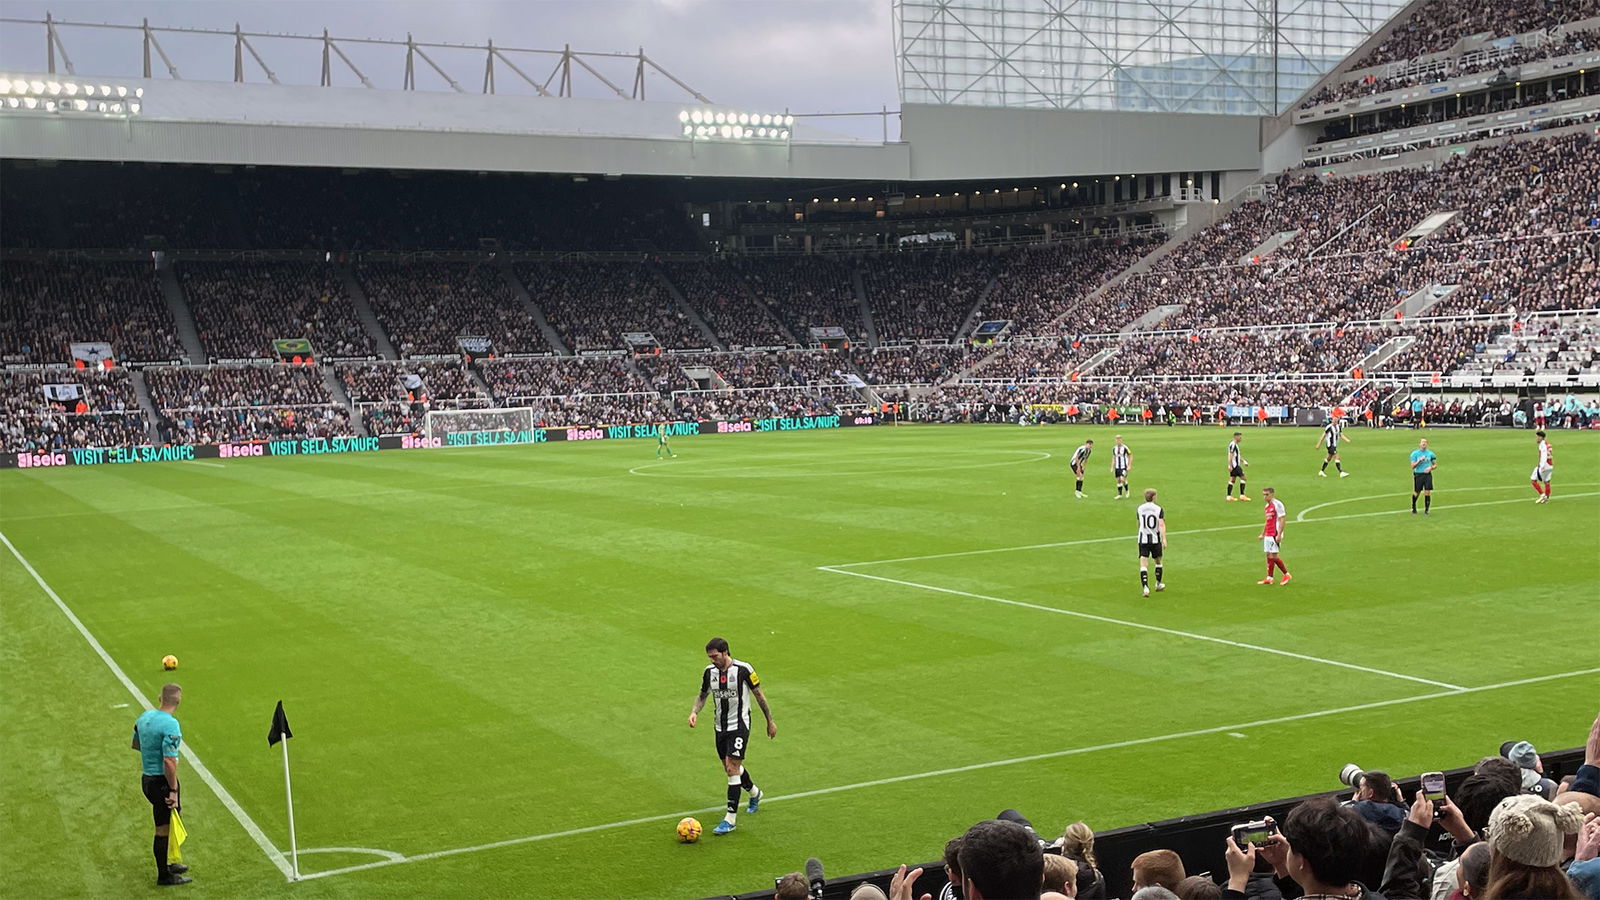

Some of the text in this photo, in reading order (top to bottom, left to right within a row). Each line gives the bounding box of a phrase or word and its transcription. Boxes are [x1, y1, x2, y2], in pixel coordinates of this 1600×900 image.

[578, 422, 700, 440] sela VISIT SELAA/NUFC
[728, 420, 752, 433] sela
[233, 437, 380, 458] sela VISIT SELA.SA/NUFC
[414, 435, 442, 448] sea
[33, 450, 66, 467] sela
[73, 448, 104, 465] VISIT
[1142, 514, 1157, 529] 10
[734, 737, 743, 749] 8
